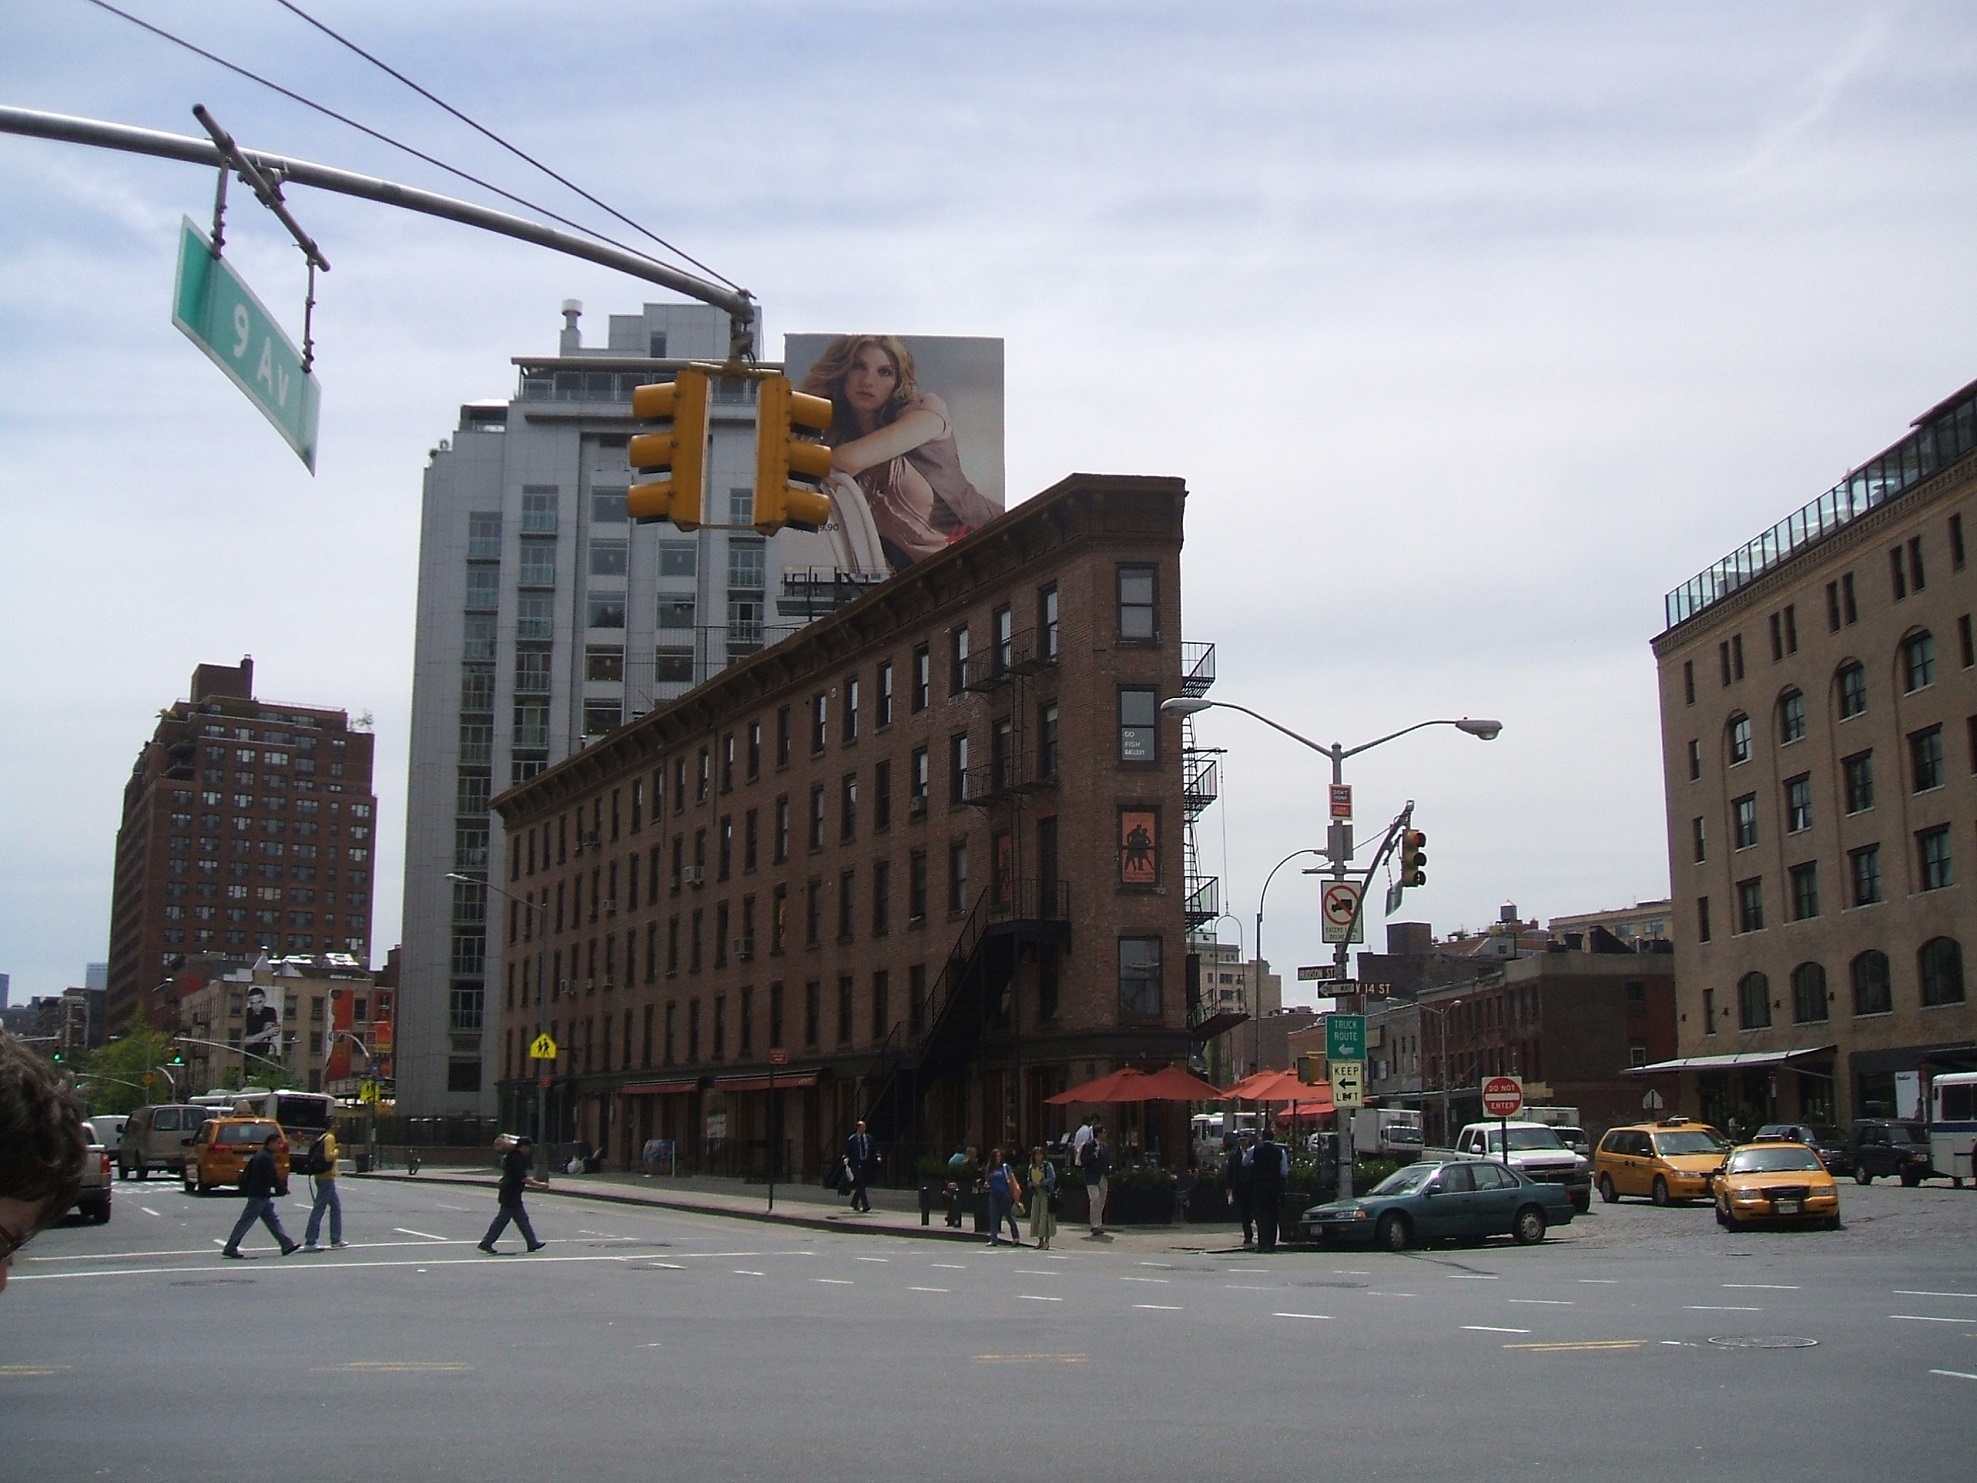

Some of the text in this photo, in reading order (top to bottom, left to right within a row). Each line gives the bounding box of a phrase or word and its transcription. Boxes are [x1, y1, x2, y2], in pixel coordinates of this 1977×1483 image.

[233, 303, 289, 409] 9 AV
[1299, 968, 1335, 980] HUDSON ST
[1323, 984, 1352, 993] ONE WAY
[1364, 983, 1375, 994] 14
[1379, 983, 1391, 994] ST
[1334, 1020, 1358, 1029] TRUCK
[1334, 1031, 1358, 1041] ROUTE
[1334, 1066, 1359, 1076] KEEP
[1336, 1092, 1358, 1102] LEFT
